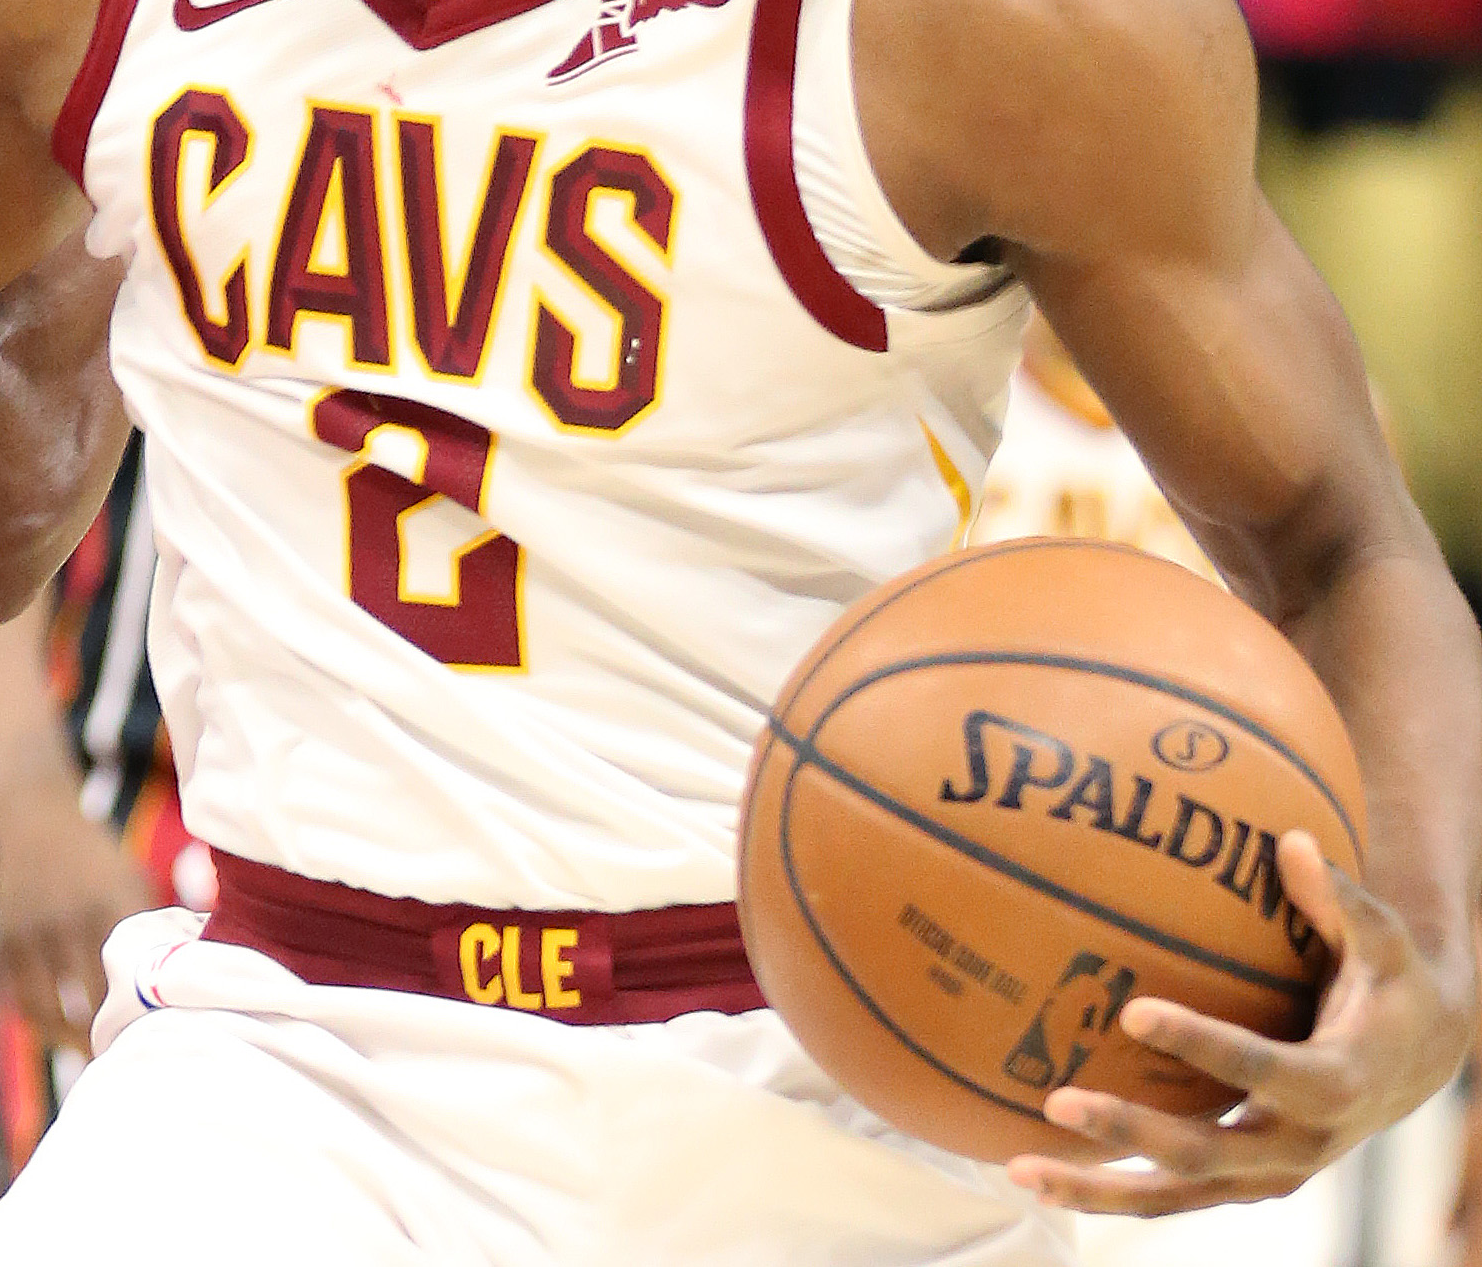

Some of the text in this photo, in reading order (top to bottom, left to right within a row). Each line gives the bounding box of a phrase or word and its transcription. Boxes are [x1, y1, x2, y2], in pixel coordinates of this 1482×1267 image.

[146, 82, 683, 439] CAVS
[306, 385, 530, 675] 2
[459, 921, 582, 1011] CLE
